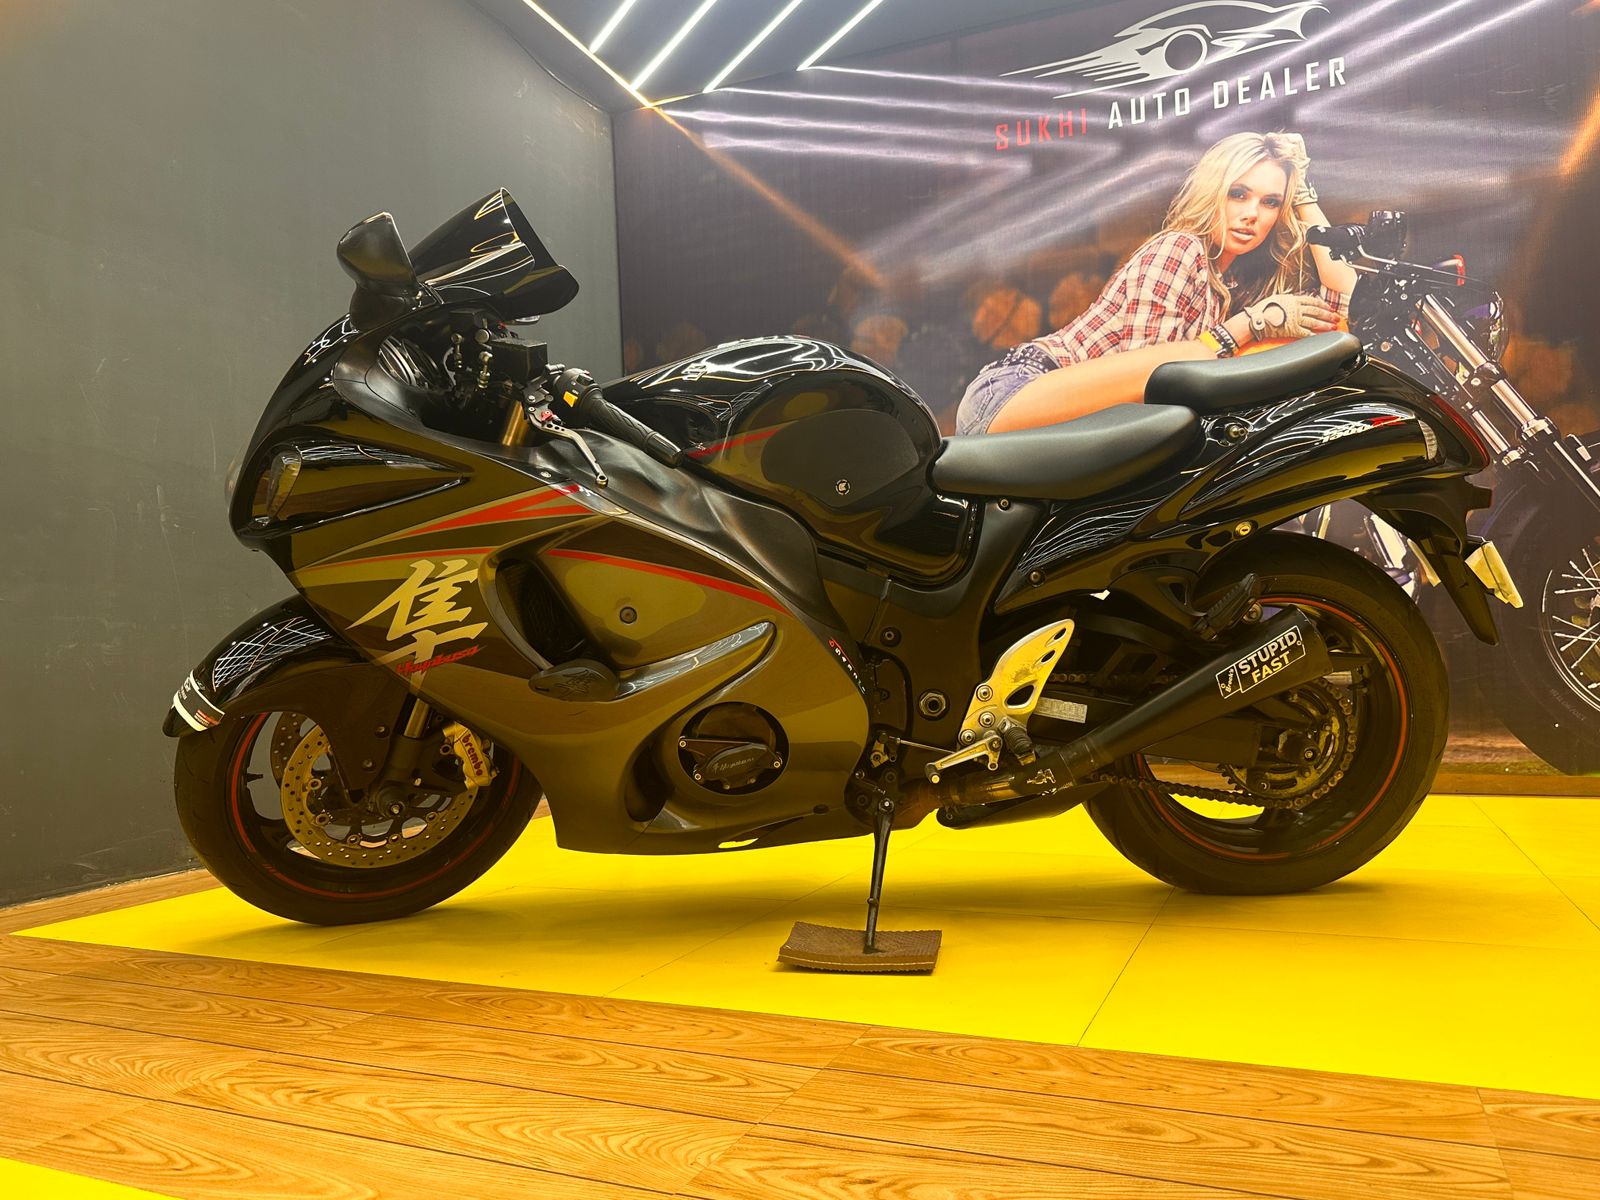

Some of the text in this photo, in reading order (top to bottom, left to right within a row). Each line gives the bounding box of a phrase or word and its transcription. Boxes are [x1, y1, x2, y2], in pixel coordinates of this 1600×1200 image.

[996, 56, 1347, 151] SUKHI AUTO DEALER
[1239, 631, 1298, 675] STUPID
[1252, 651, 1291, 684] FAST
[461, 733, 484, 776] brembo
